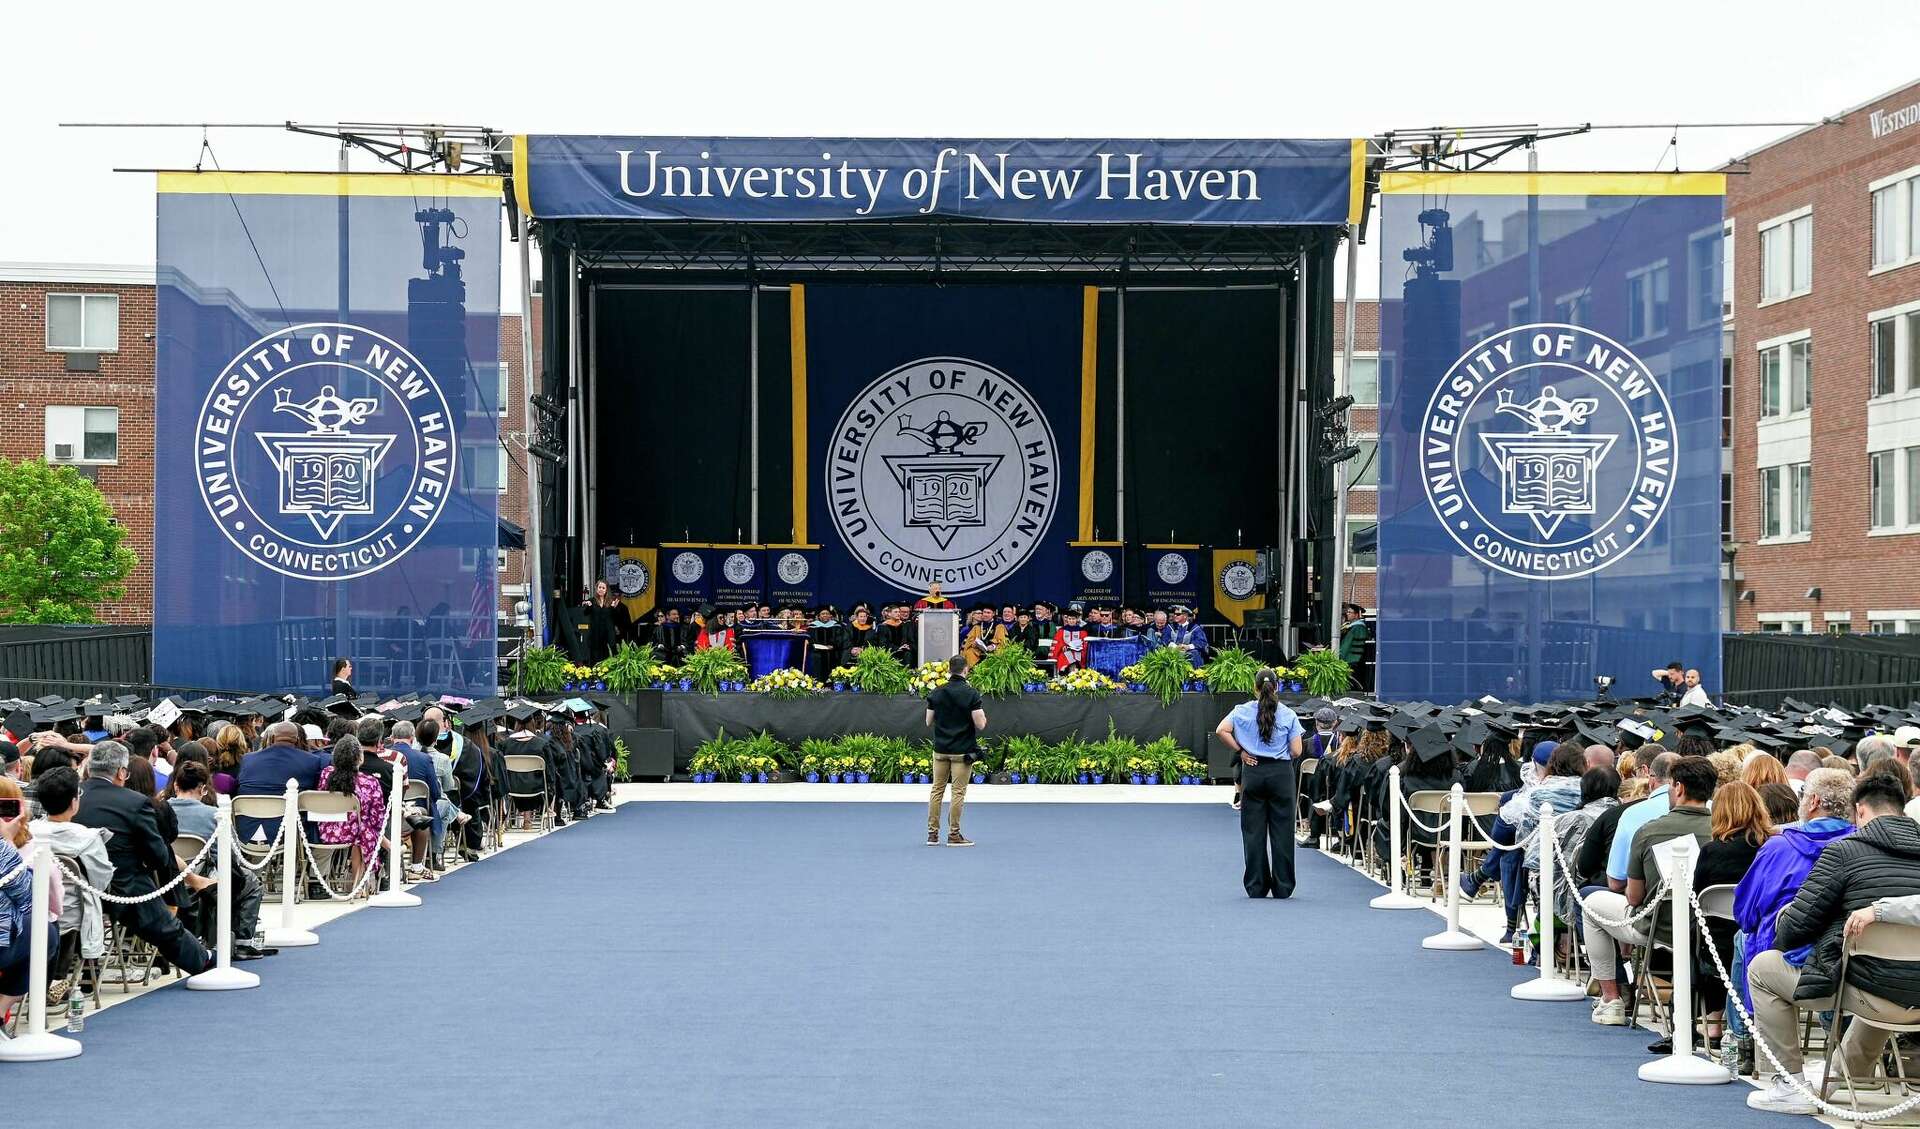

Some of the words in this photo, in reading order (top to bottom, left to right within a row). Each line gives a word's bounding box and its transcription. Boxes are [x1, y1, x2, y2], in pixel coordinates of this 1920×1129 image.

[616, 150, 888, 215] University
[902, 148, 957, 214] of
[964, 152, 1082, 201] New
[1096, 152, 1262, 201] Haven
[204, 338, 292, 517] UNIVERSITY
[310, 333, 354, 356] OF
[366, 344, 430, 400] NEW
[408, 412, 447, 520] HAVEN
[836, 376, 912, 538] UNIVERSITY
[929, 369, 966, 390] OF
[976, 378, 1034, 430] NEW
[1016, 440, 1049, 538] HAVEN
[1428, 340, 1514, 518] UNIVERSITY
[1532, 333, 1576, 356] OF
[1585, 343, 1652, 401] NEW
[1630, 411, 1670, 520] HAVEN
[250, 533, 398, 572] CONNECTICUT
[878, 548, 1008, 583] CONNECTICUT
[1473, 532, 1621, 570] CONNECTICUT
